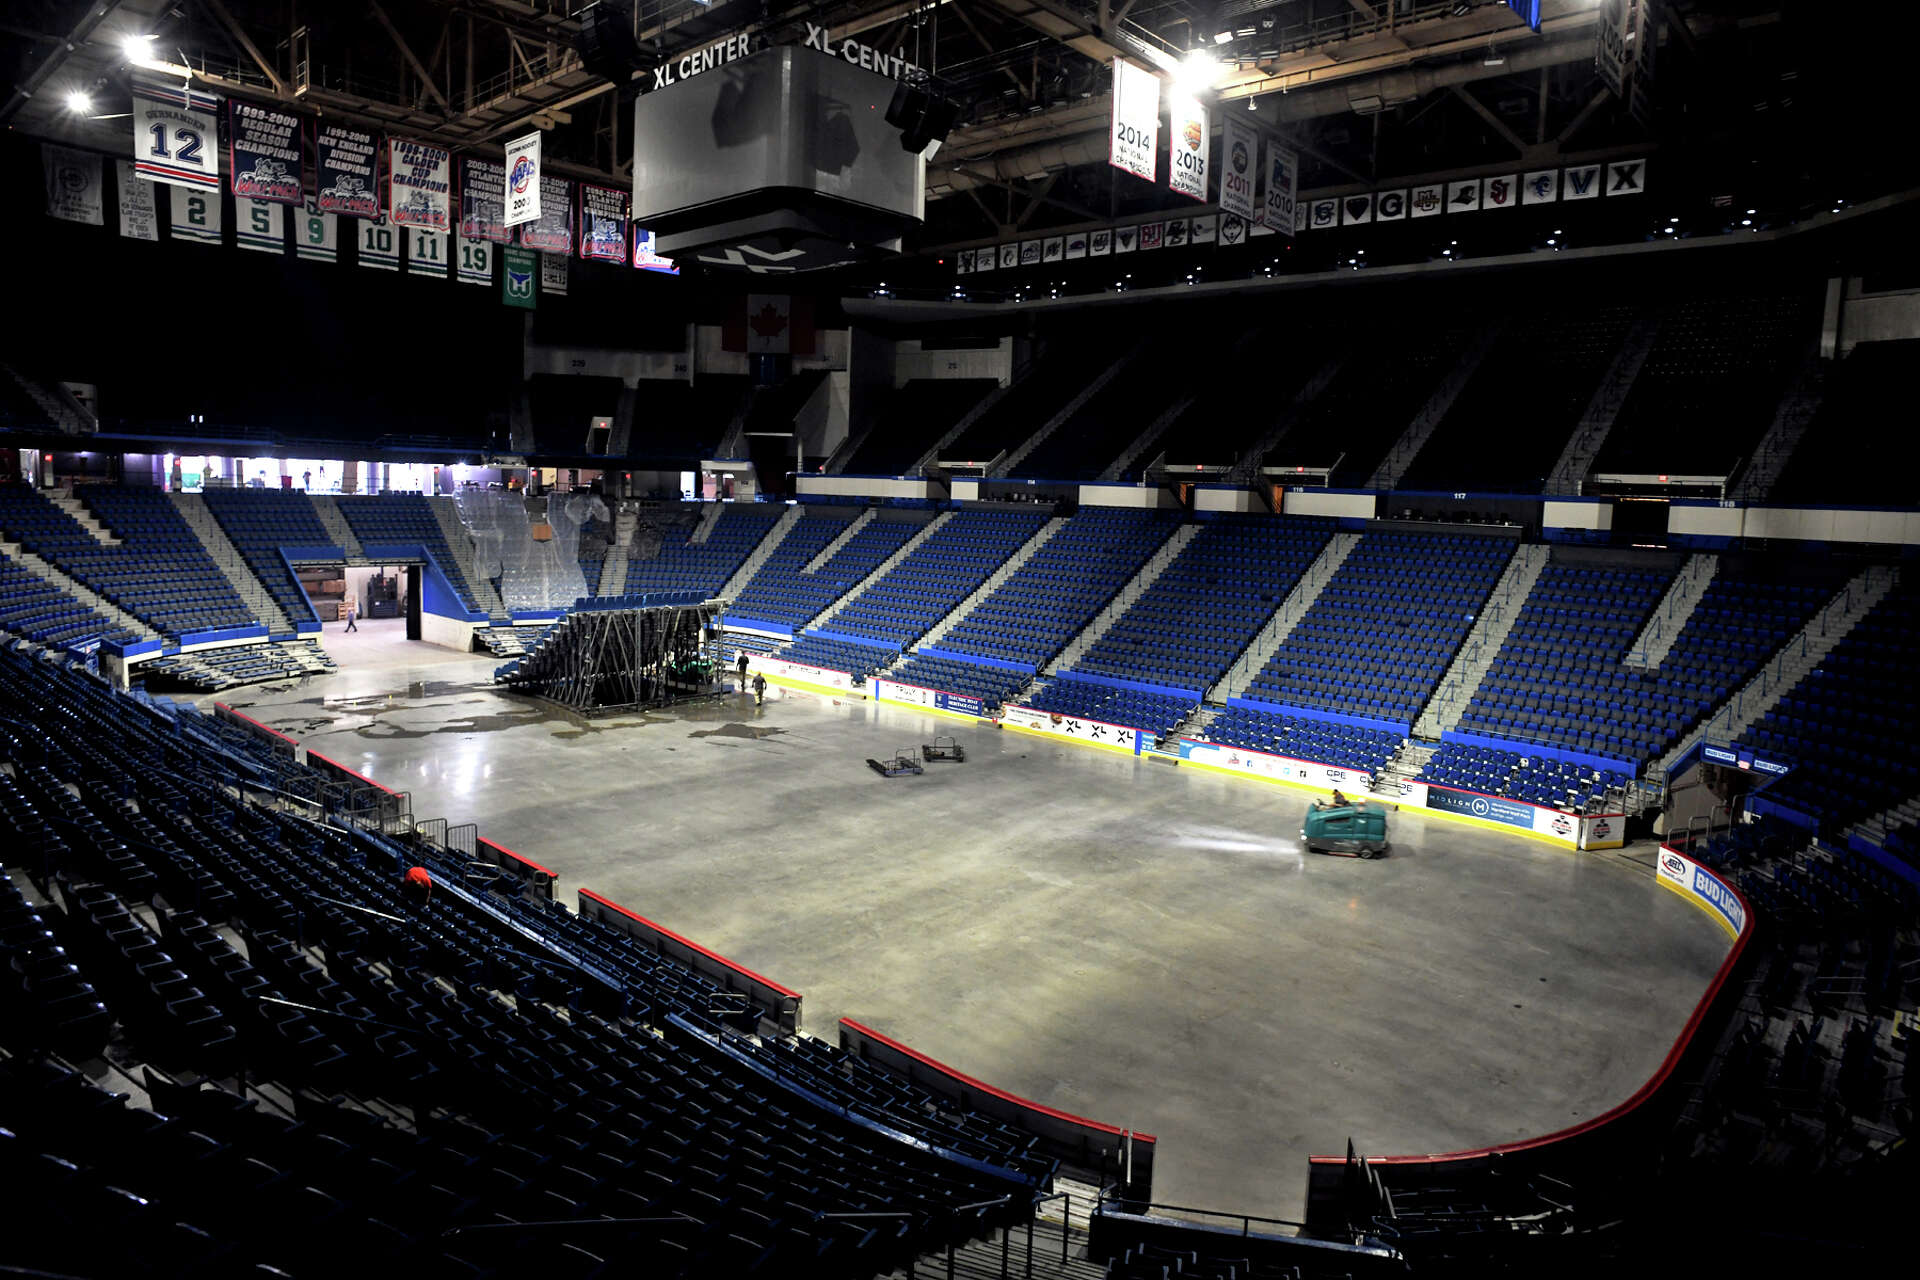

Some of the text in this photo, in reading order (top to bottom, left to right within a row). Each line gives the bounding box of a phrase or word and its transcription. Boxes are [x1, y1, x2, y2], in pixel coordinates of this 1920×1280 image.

[653, 33, 749, 91] XL CENTER
[805, 21, 918, 80] XL CENTE
[235, 104, 299, 129] 1999-2000
[241, 117, 293, 138] REGULAR
[149, 122, 204, 167] 12
[245, 130, 290, 149] SEASON
[319, 135, 375, 156] NEW ENGLAND
[326, 126, 370, 144] 1999-2000
[1117, 122, 1150, 151] 2014
[235, 139, 300, 162] CHAMPIONS
[330, 149, 367, 165] DIVISION
[394, 142, 448, 163] 1999-2000
[1176, 149, 1204, 175] 2013
[325, 159, 371, 177] CHAMPIONS
[402, 154, 440, 172] CALDER
[411, 167, 431, 180] CUP
[393, 173, 448, 195] CHAMPIONS
[1226, 172, 1250, 196] 2011
[1569, 170, 1596, 195] V
[1611, 164, 1639, 191] X
[187, 197, 206, 226] 2
[1268, 190, 1293, 214] 2010
[1380, 193, 1404, 217] G
[251, 207, 270, 233] 5
[308, 217, 324, 244] 9
[366, 228, 392, 252] 10
[417, 235, 439, 261] 11
[462, 245, 488, 272] 19
[1066, 719, 1081, 733] XL
[1091, 724, 1107, 739] XL
[1117, 730, 1134, 744] XL
[1326, 769, 1347, 780] CPE
[1695, 871, 1743, 928] BUD LIGHT
